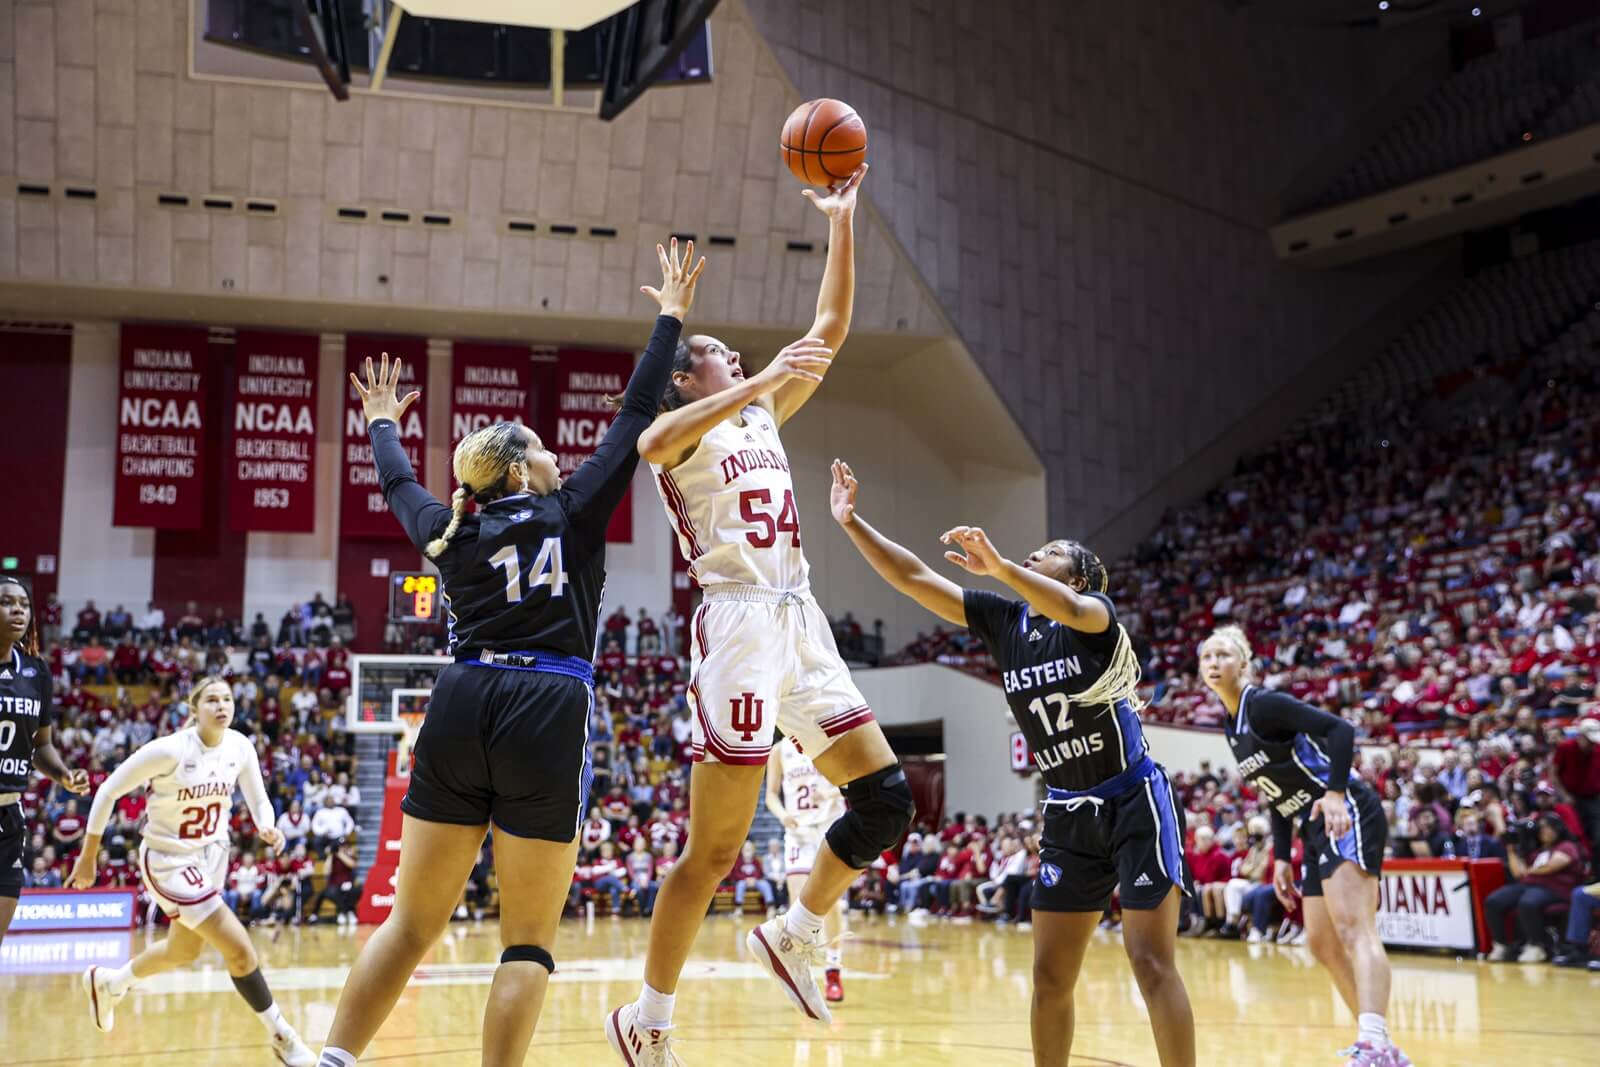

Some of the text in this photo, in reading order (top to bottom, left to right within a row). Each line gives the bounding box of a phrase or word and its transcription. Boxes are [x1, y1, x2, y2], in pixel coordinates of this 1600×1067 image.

[134, 349, 192, 370] INDIANA
[249, 354, 305, 375] INDIANA
[124, 371, 201, 392] UNIVERSITY
[239, 377, 312, 398] UNIVERSITY
[464, 366, 519, 387] INDIANA
[569, 371, 622, 390] INDIANA
[456, 387, 527, 409] UNIVERSITY
[120, 397, 201, 429] NCAA
[235, 403, 314, 434] NCAA
[346, 408, 423, 438] NA
[557, 418, 609, 447] NCA
[121, 434, 196, 456] BASKETBALL
[235, 438, 310, 461] BASKETBALL
[122, 457, 194, 478] CHAMPIONS
[238, 462, 307, 482] CHAMPIONS
[720, 449, 790, 485] INDIAN
[139, 485, 177, 505] 1940
[254, 488, 289, 509] 1953
[739, 488, 801, 549] 54
[487, 537, 570, 603] 14
[1003, 655, 1082, 694] EASTERN
[0, 696, 41, 717] TERN
[1028, 692, 1074, 736] 12
[1033, 732, 1105, 772] ILLINOIS
[176, 781, 231, 802] INDIAN
[178, 802, 222, 840] 20
[76, 902, 125, 919] BANK
